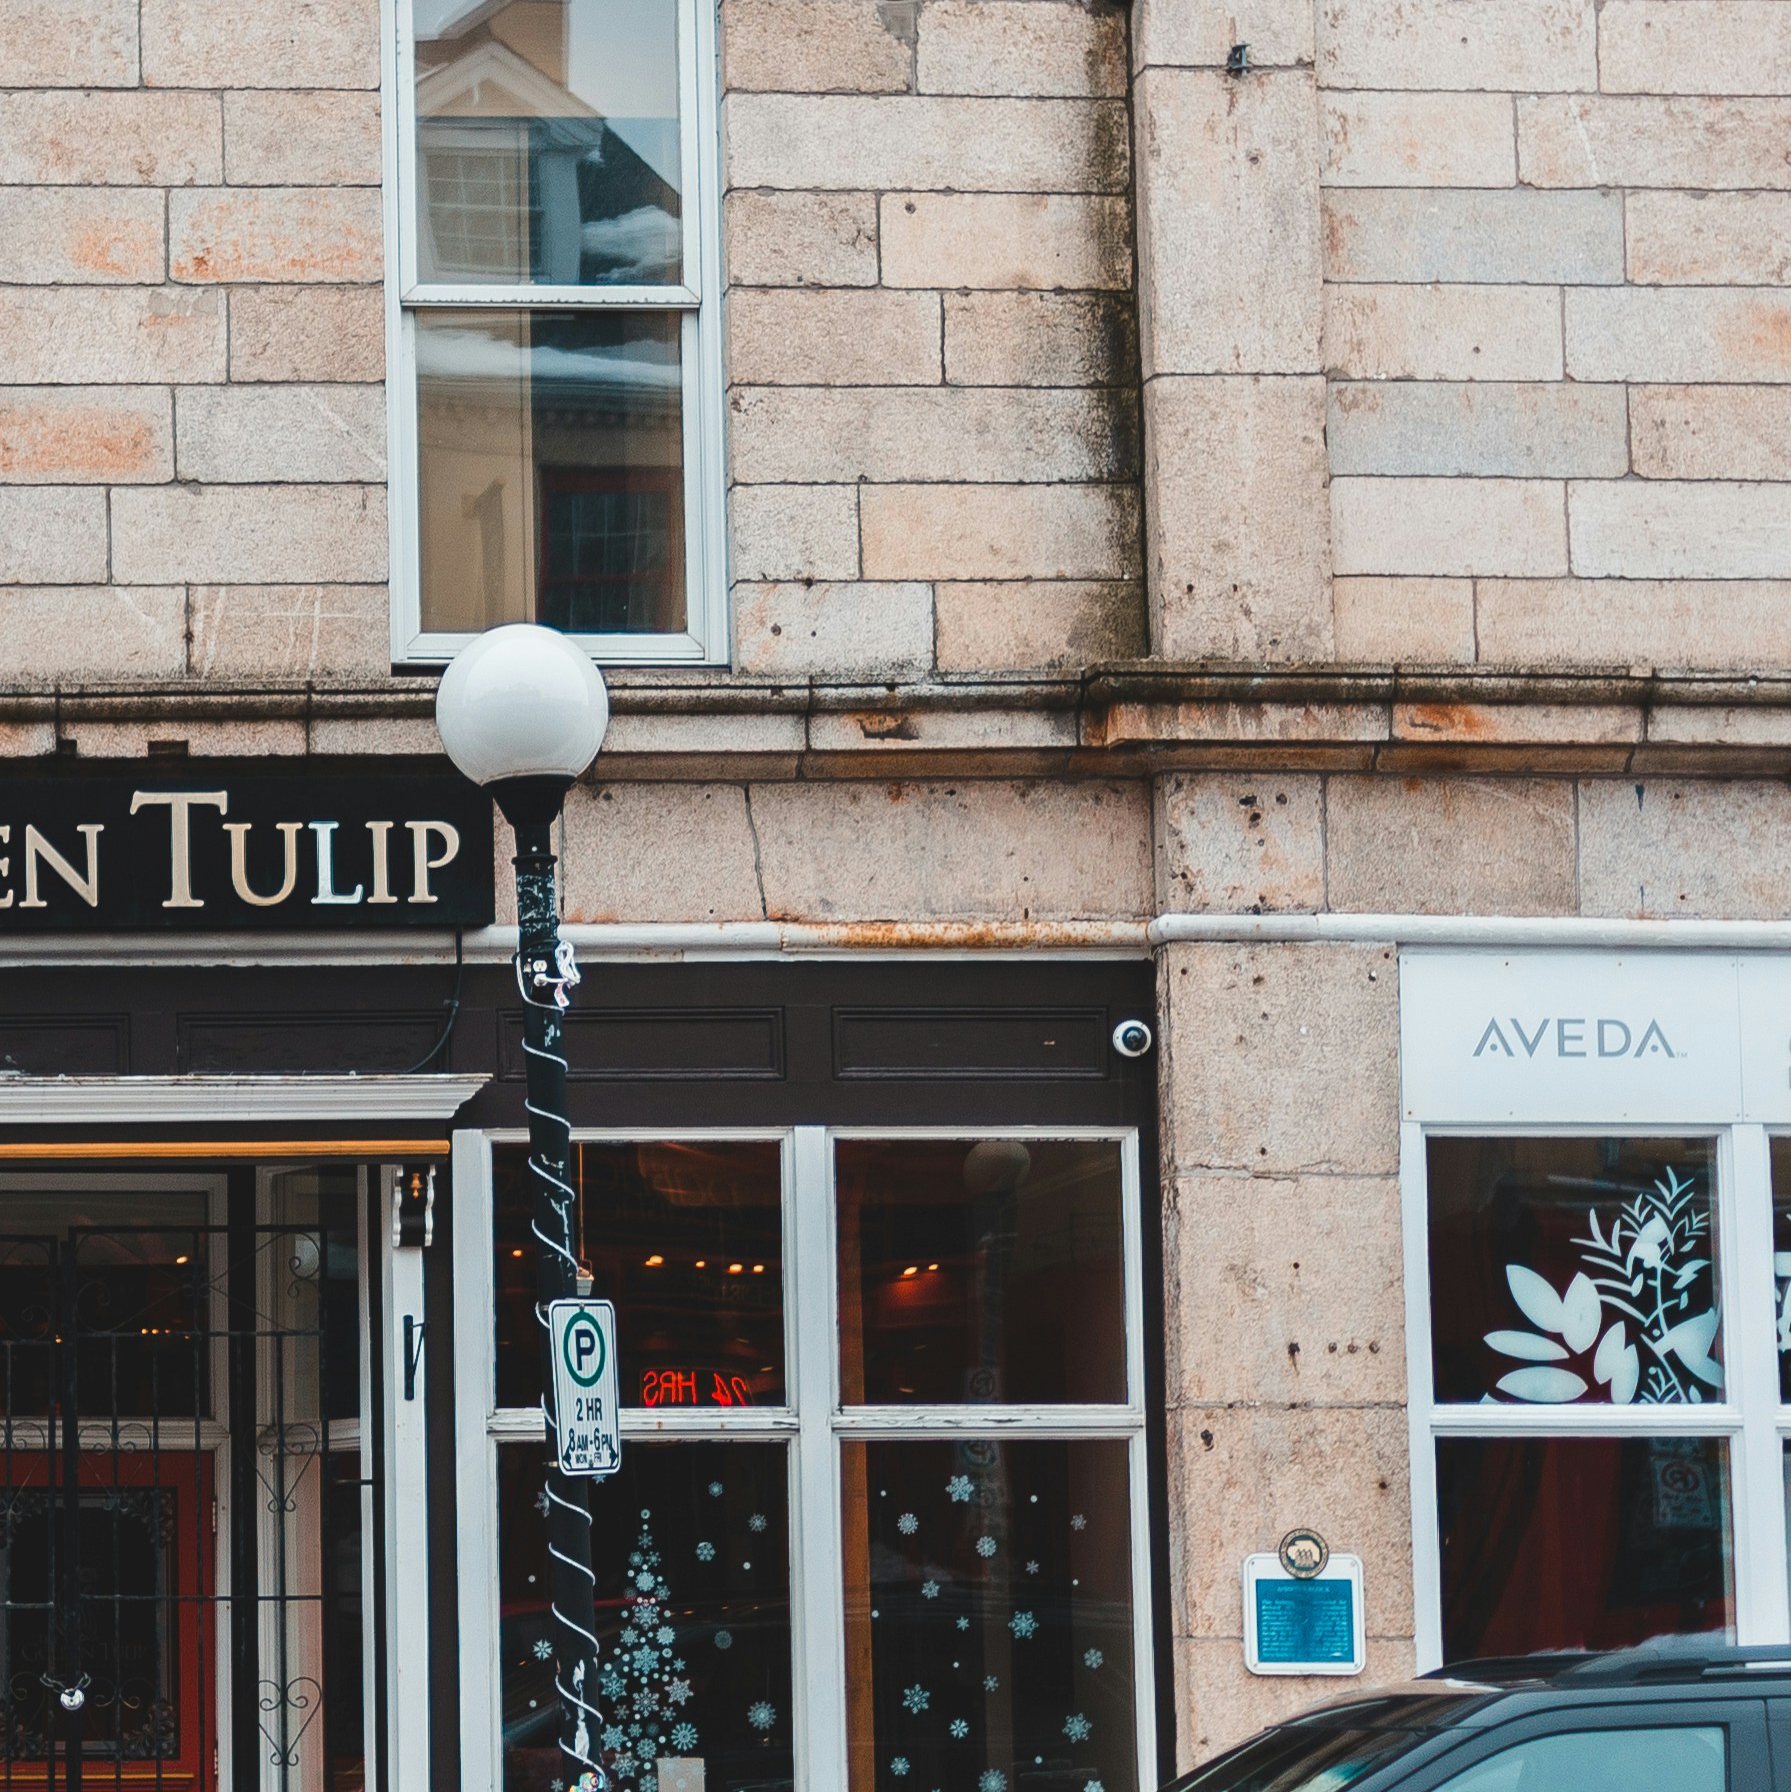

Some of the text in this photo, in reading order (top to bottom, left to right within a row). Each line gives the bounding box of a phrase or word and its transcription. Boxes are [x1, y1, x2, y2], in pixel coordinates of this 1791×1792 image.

[129, 789, 460, 908] TULIP
[1472, 1018, 1675, 1058] AVEDA
[575, 1328, 596, 1372] P
[575, 1396, 603, 1422] 2 HR
